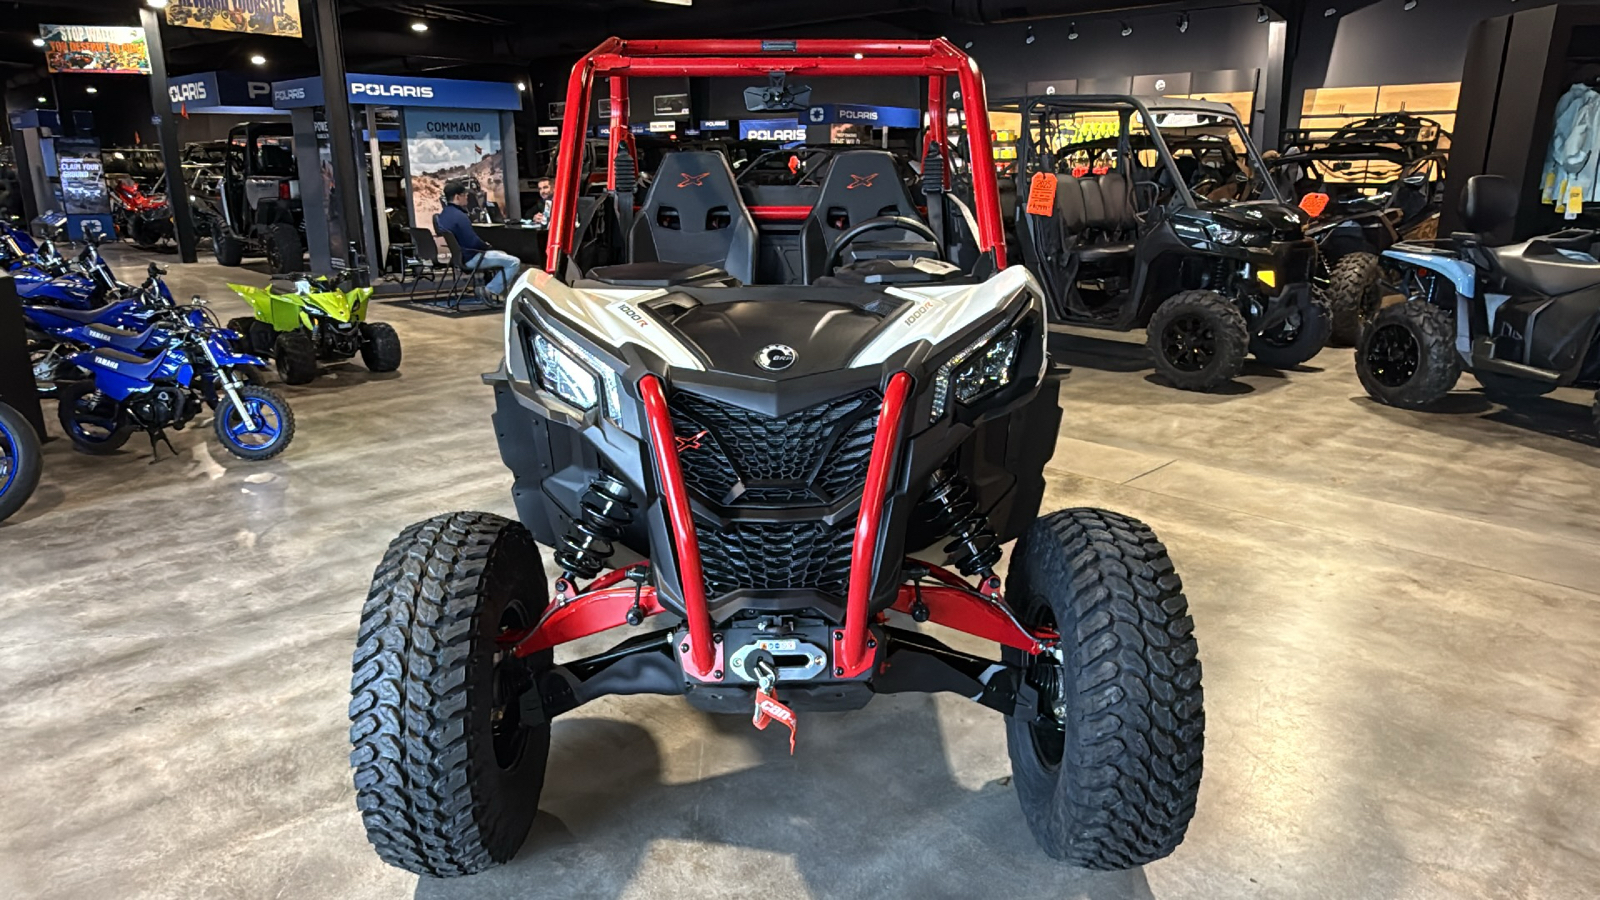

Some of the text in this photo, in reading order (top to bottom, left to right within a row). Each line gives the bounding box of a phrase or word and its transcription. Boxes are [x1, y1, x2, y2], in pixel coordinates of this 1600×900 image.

[60, 26, 84, 42] STOP
[69, 41, 106, 53] DESERVE
[169, 81, 207, 102] OLARIS
[275, 87, 306, 101] POLARIS
[351, 83, 434, 98] POLARIS
[840, 110, 878, 120] POLARIS
[426, 121, 481, 133] COMMAND
[747, 129, 807, 141] POLARIS
[618, 304, 648, 328] 1000R
[905, 301, 933, 326] 1000R
[89, 330, 111, 342] YAMAHA
[95, 356, 119, 369] YAMAHA
